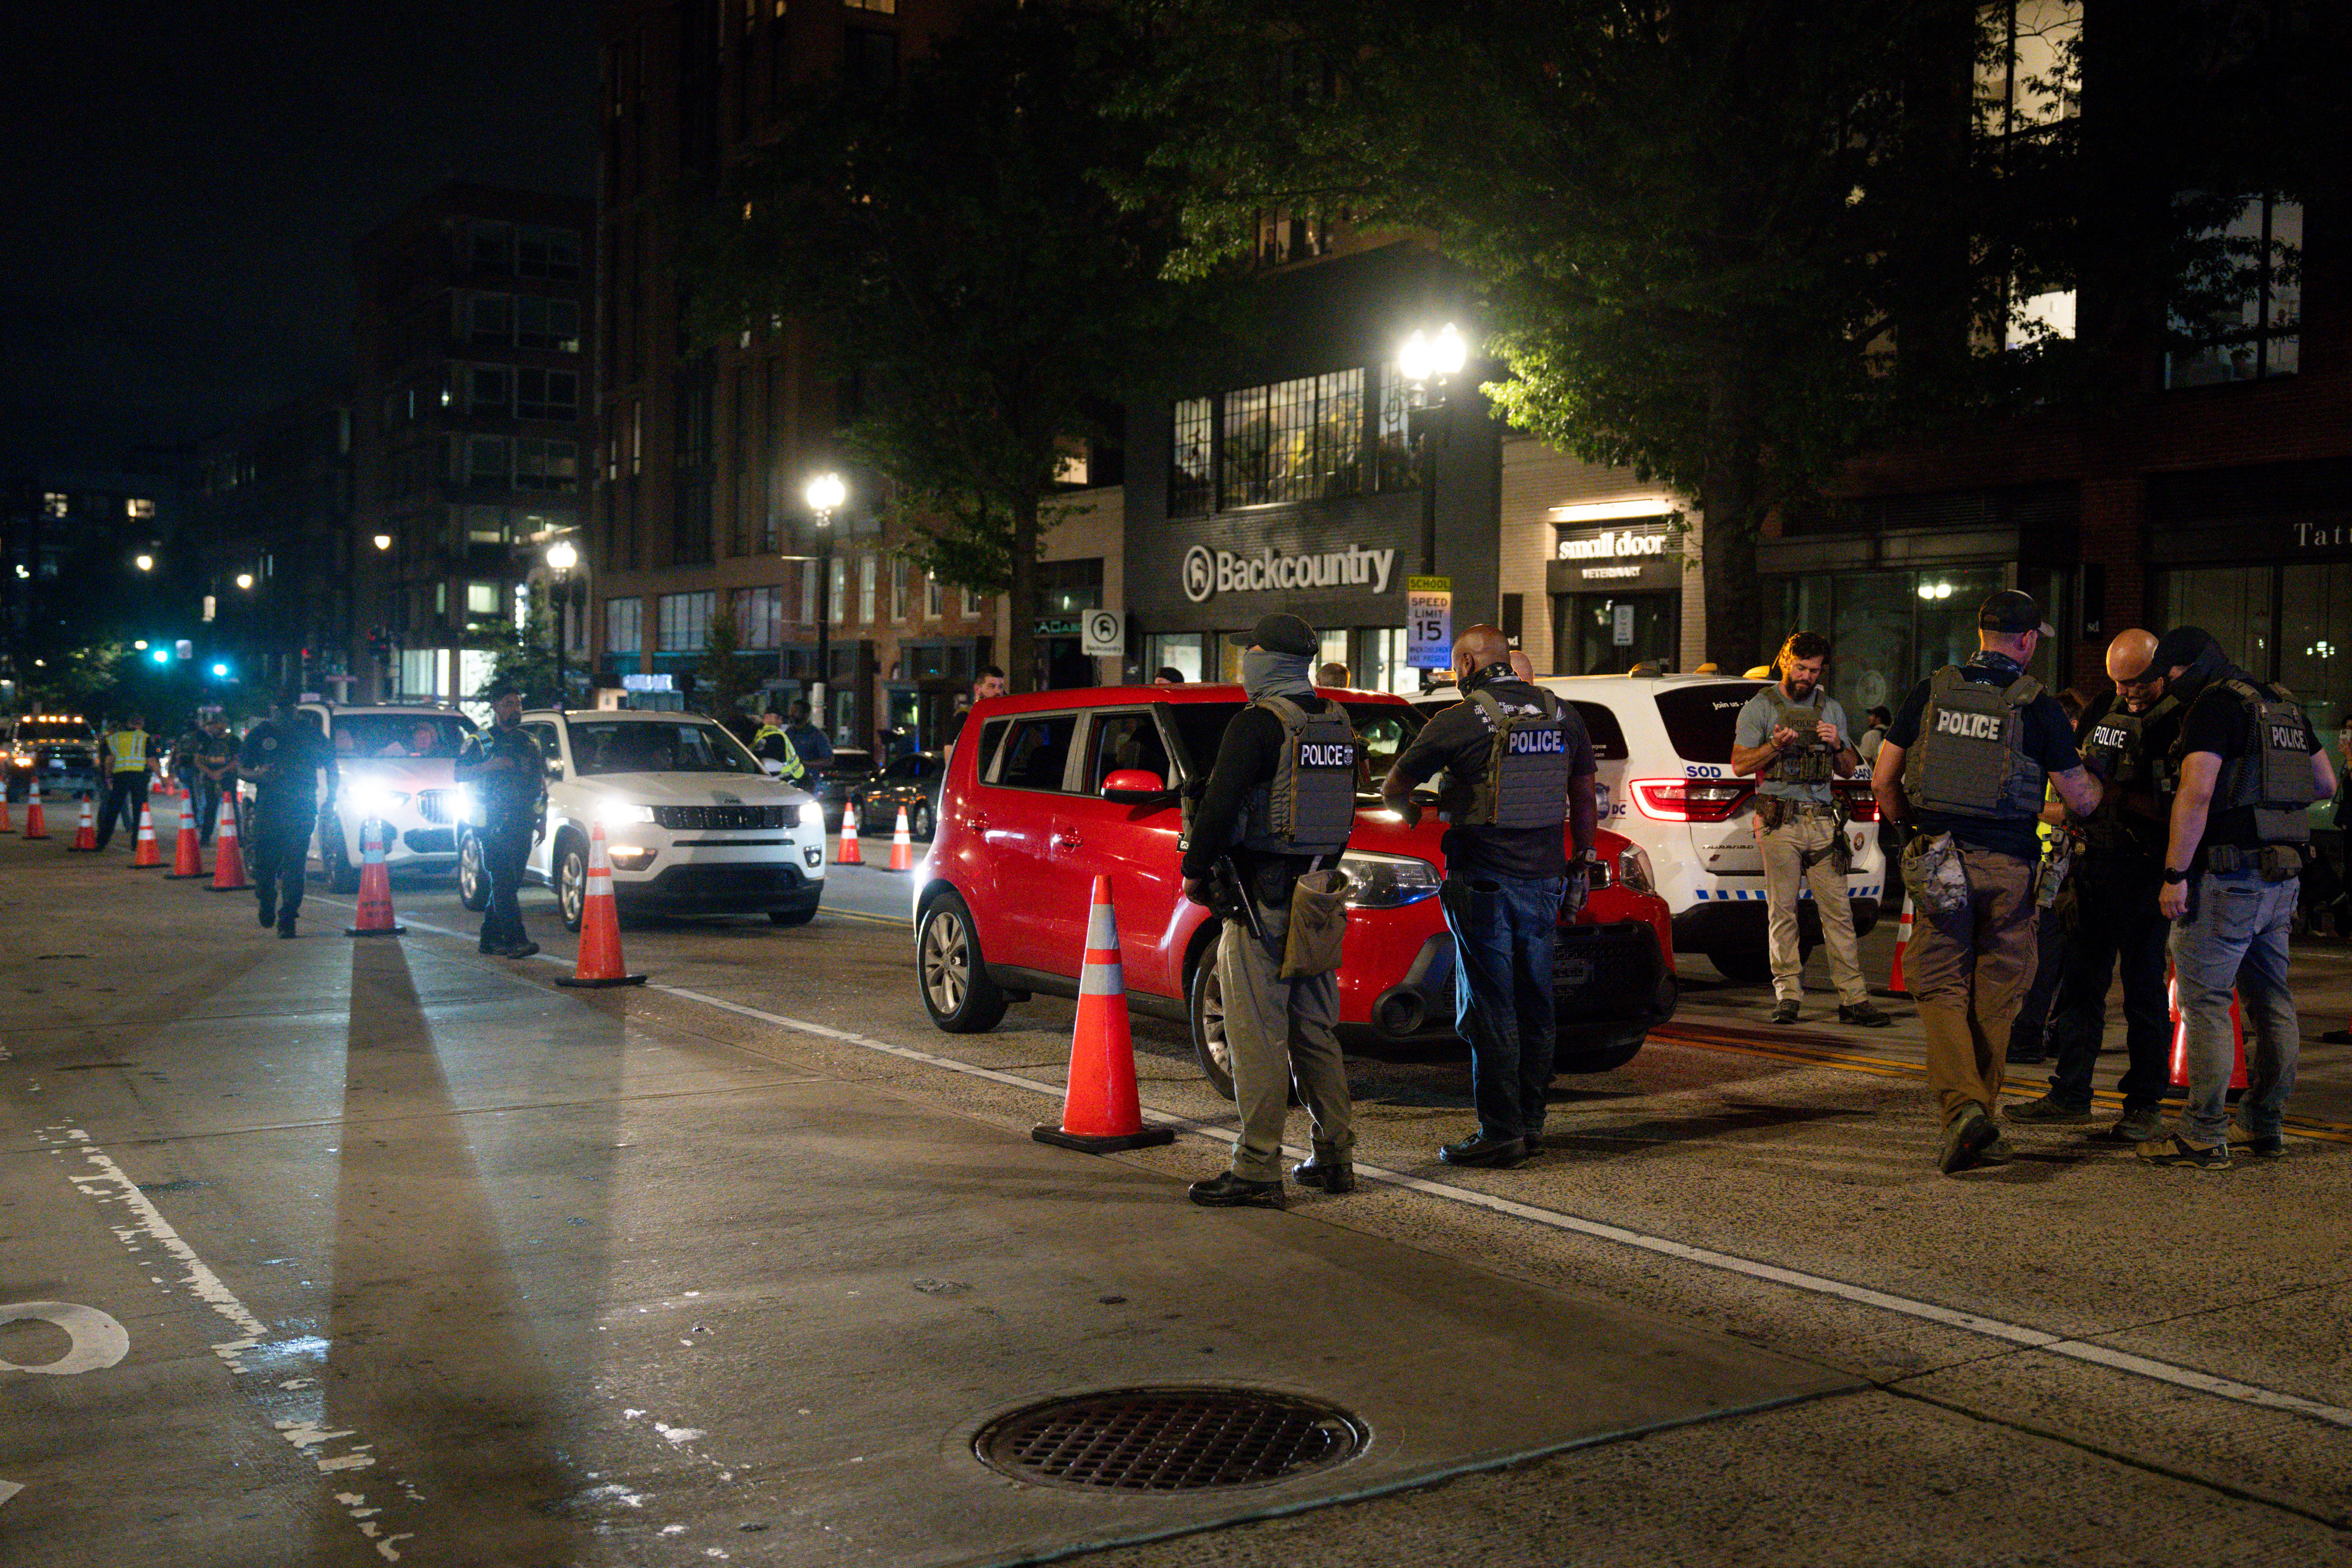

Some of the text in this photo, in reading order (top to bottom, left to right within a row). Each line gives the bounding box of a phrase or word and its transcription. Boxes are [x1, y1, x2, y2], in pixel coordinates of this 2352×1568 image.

[1559, 530, 1668, 560] small door
[1217, 543, 1395, 594] Backcountry
[1581, 566, 1641, 579] VETERINARY
[1410, 578, 1450, 588] SCHOOL
[1411, 597, 1448, 606] SPEED
[1415, 609, 1444, 618] LIMIT
[1416, 620, 1442, 641] 15
[1712, 701, 1729, 710] Join
[1937, 710, 2000, 740] POLICE
[1509, 730, 1562, 753] POLICE
[2093, 726, 2127, 748] POLICE
[2271, 726, 2307, 750] POLICE
[1301, 744, 1343, 765] POLICE
[1686, 765, 1722, 778] SOD
[1612, 804, 1626, 815] DC
